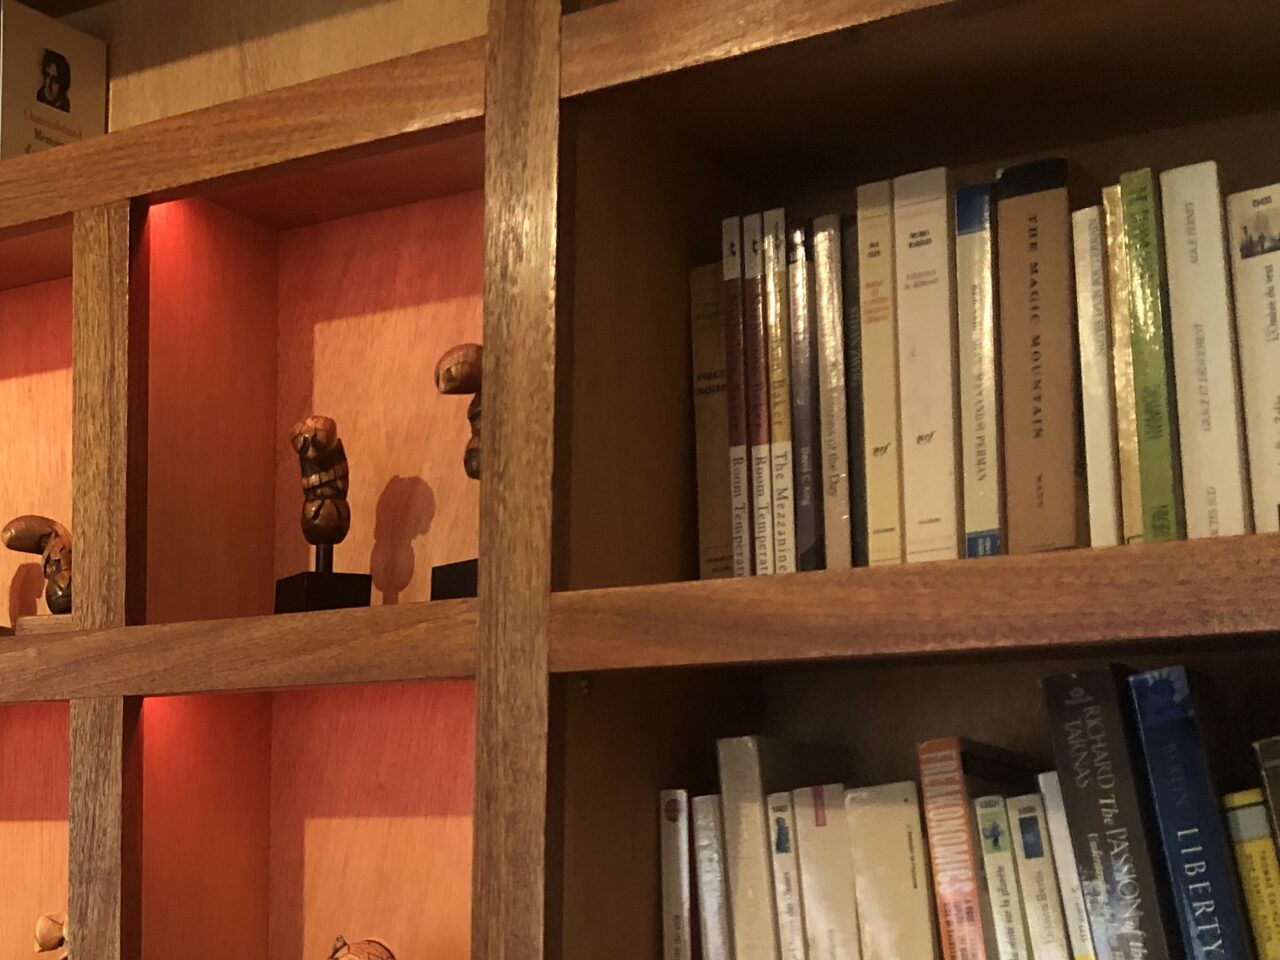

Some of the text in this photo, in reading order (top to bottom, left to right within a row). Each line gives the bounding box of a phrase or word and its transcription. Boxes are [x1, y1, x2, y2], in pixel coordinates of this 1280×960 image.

[1028, 215, 1044, 439] THE MAGIC MOUNTAIN
[733, 457, 744, 497] Room
[755, 457, 767, 497] Room
[776, 453, 788, 572] The Mezzanine
[1063, 716, 1092, 789] TARNAS
[1083, 704, 1116, 789] RICHARD
[920, 749, 976, 893] FREAKONOMICS
[1098, 793, 1119, 826] The
[1105, 827, 1143, 918] PASSION
[1176, 826, 1224, 955] LIBERTY
